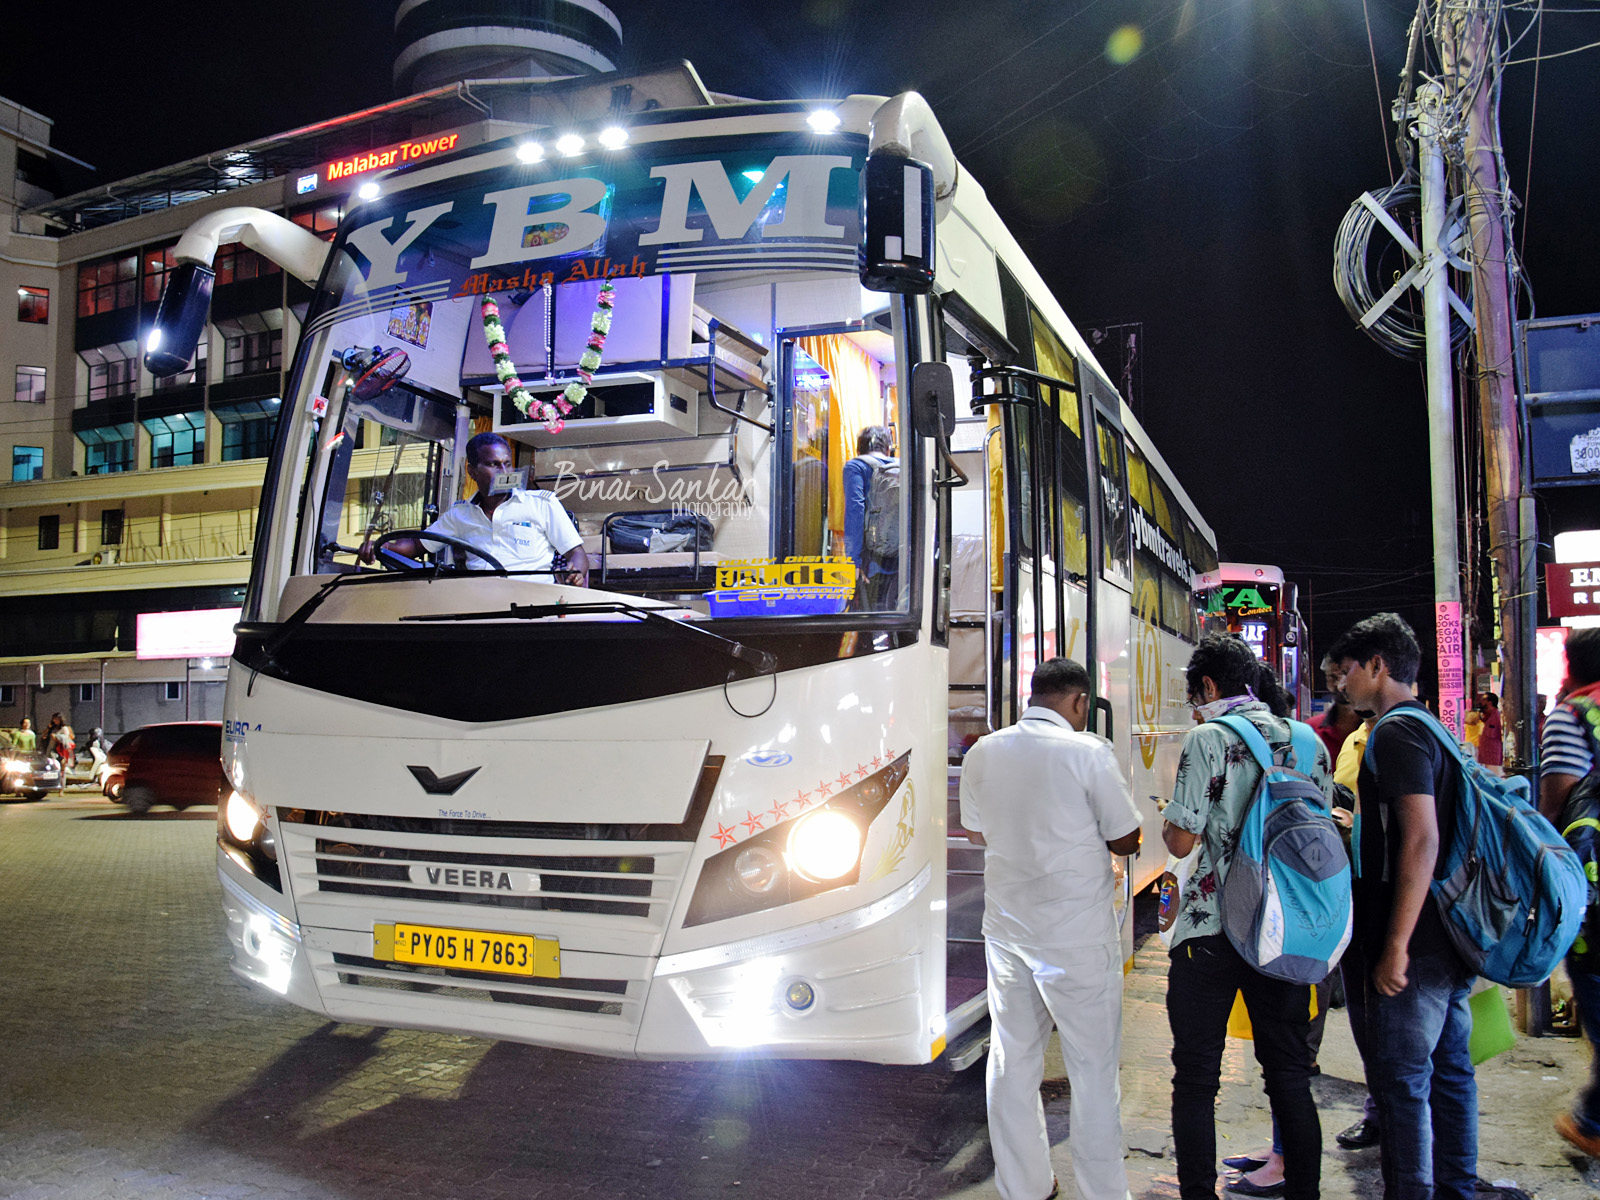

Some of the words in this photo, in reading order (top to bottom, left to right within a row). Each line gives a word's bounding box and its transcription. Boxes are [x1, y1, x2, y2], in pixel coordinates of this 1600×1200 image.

[327, 150, 398, 181] Malabar
[400, 133, 459, 161] Tower
[346, 154, 852, 297] YBM
[452, 268, 555, 303] Masha
[561, 254, 648, 289] Allah
[717, 556, 778, 567] DOLBY
[784, 555, 855, 563] DIGITAL
[719, 567, 778, 588] JBL
[784, 565, 852, 585] dts
[1238, 606, 1273, 616] Connect
[1436, 628, 1459, 636] EGA
[1437, 636, 1459, 644] OOK
[1442, 709, 1455, 717] DC
[438, 808, 448, 817] The
[449, 809, 463, 818] Force
[464, 810, 472, 818] To
[426, 867, 513, 891] VEERA
[411, 931, 457, 960] PY05
[464, 938, 475, 962] H
[481, 940, 528, 967] 7863
